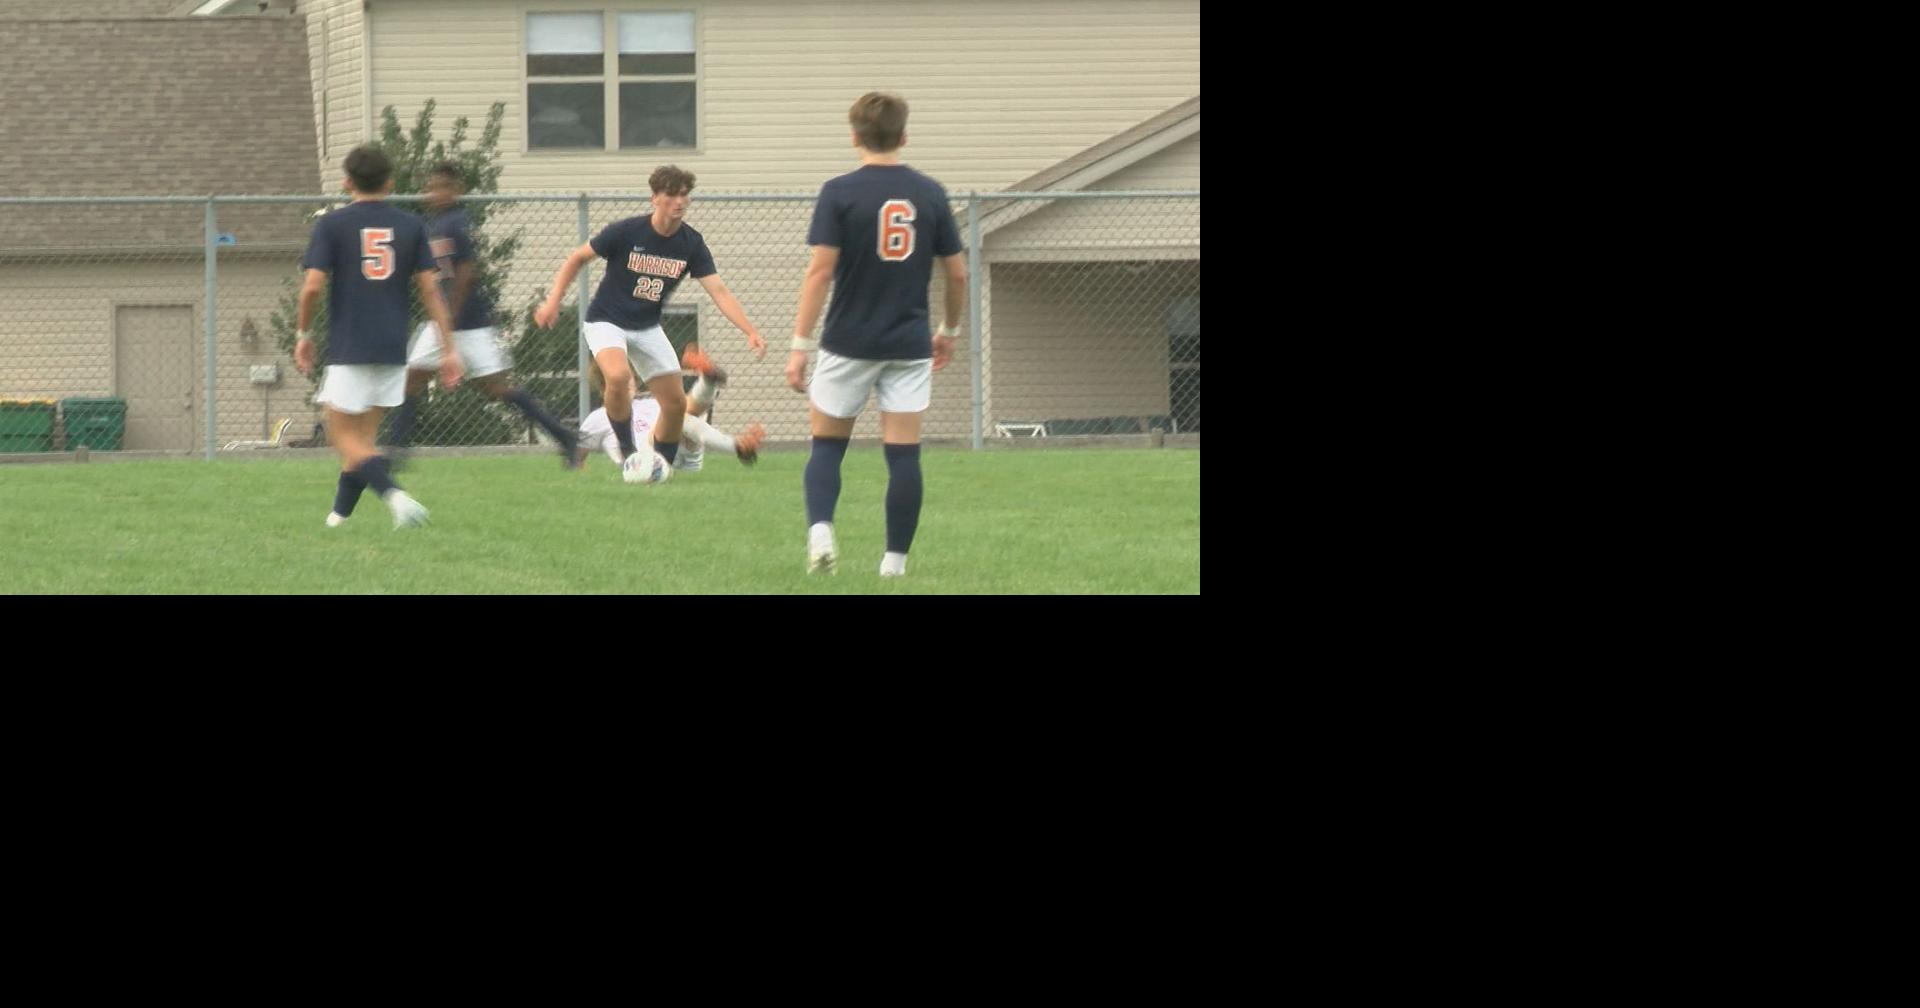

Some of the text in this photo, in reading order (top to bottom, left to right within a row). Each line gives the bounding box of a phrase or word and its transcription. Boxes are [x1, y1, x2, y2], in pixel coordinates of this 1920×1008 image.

[360, 227, 396, 280] 5
[877, 199, 917, 262] 6
[633, 276, 664, 302] 22
